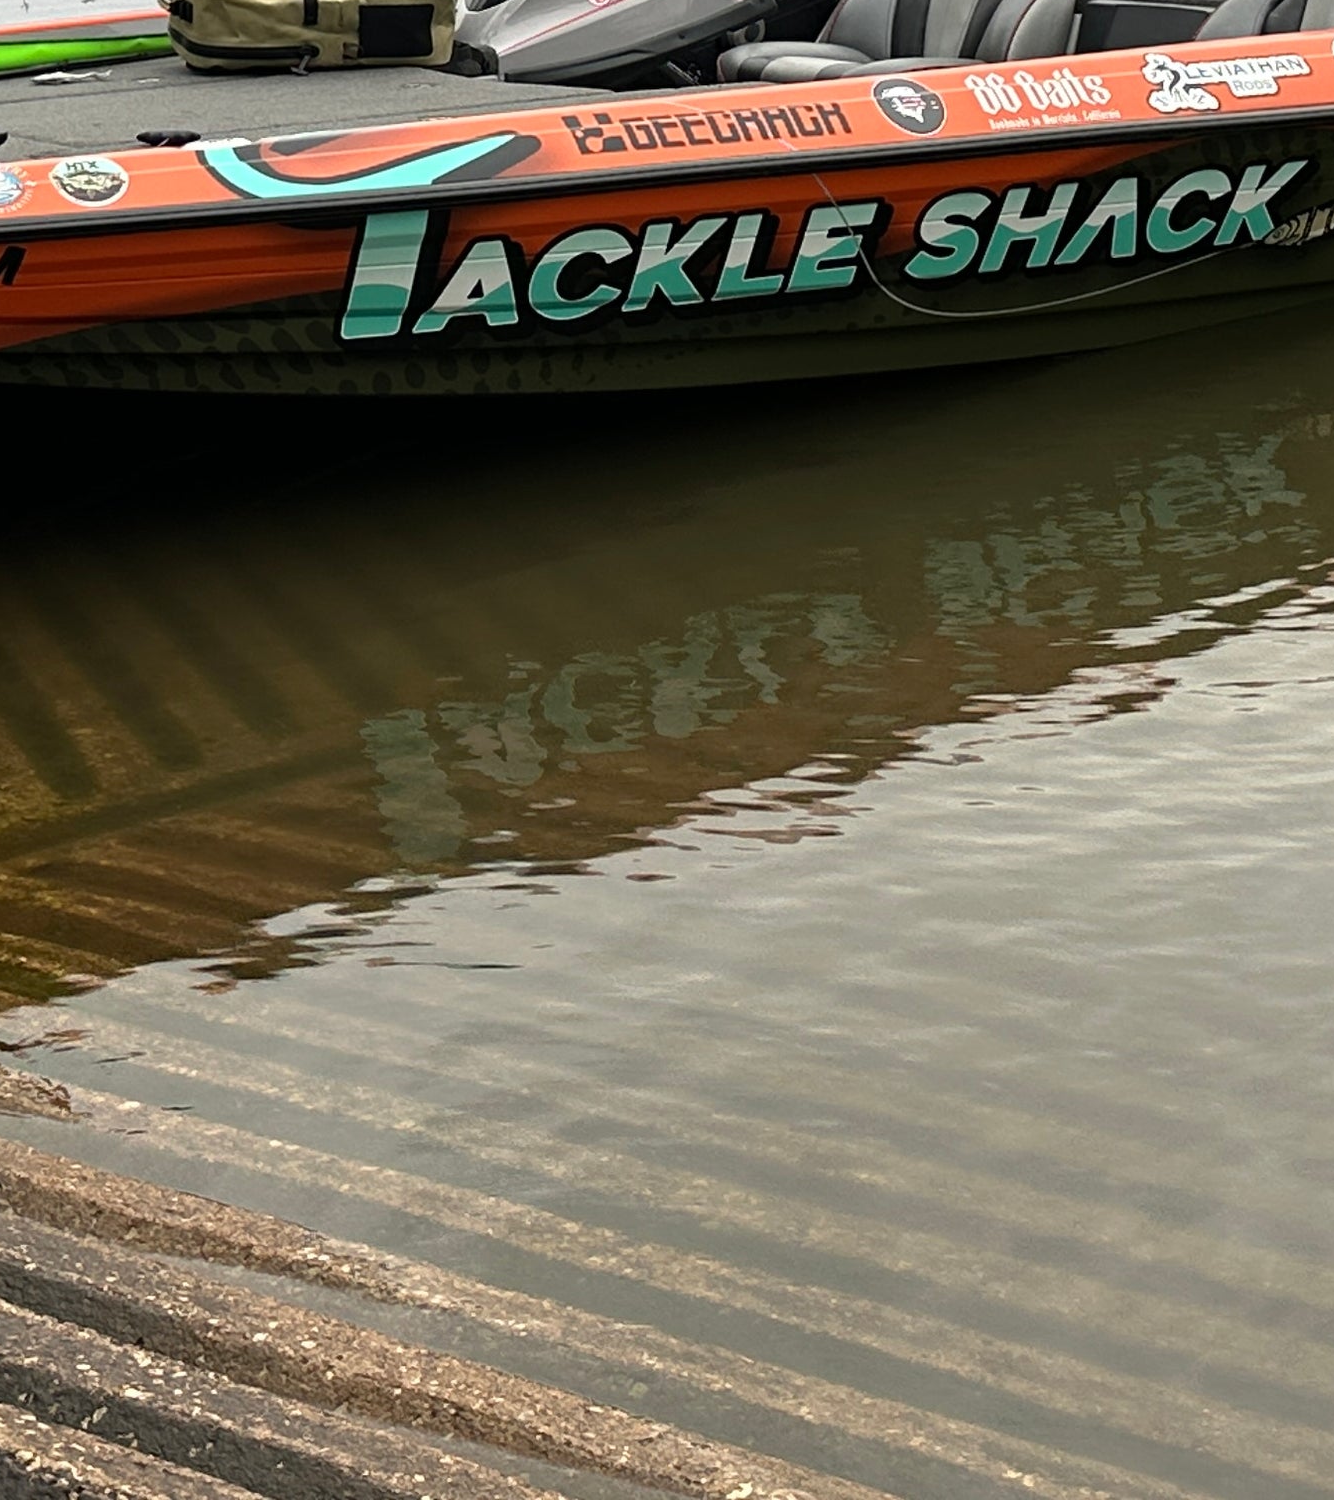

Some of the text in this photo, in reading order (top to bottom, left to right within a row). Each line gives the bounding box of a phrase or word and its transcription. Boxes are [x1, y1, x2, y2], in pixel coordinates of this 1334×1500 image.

[964, 67, 1113, 116] 88 Baits
[1183, 57, 1305, 80] LEVIATHAN
[620, 102, 852, 150] GEECRACK
[904, 159, 1309, 279] SHACK
